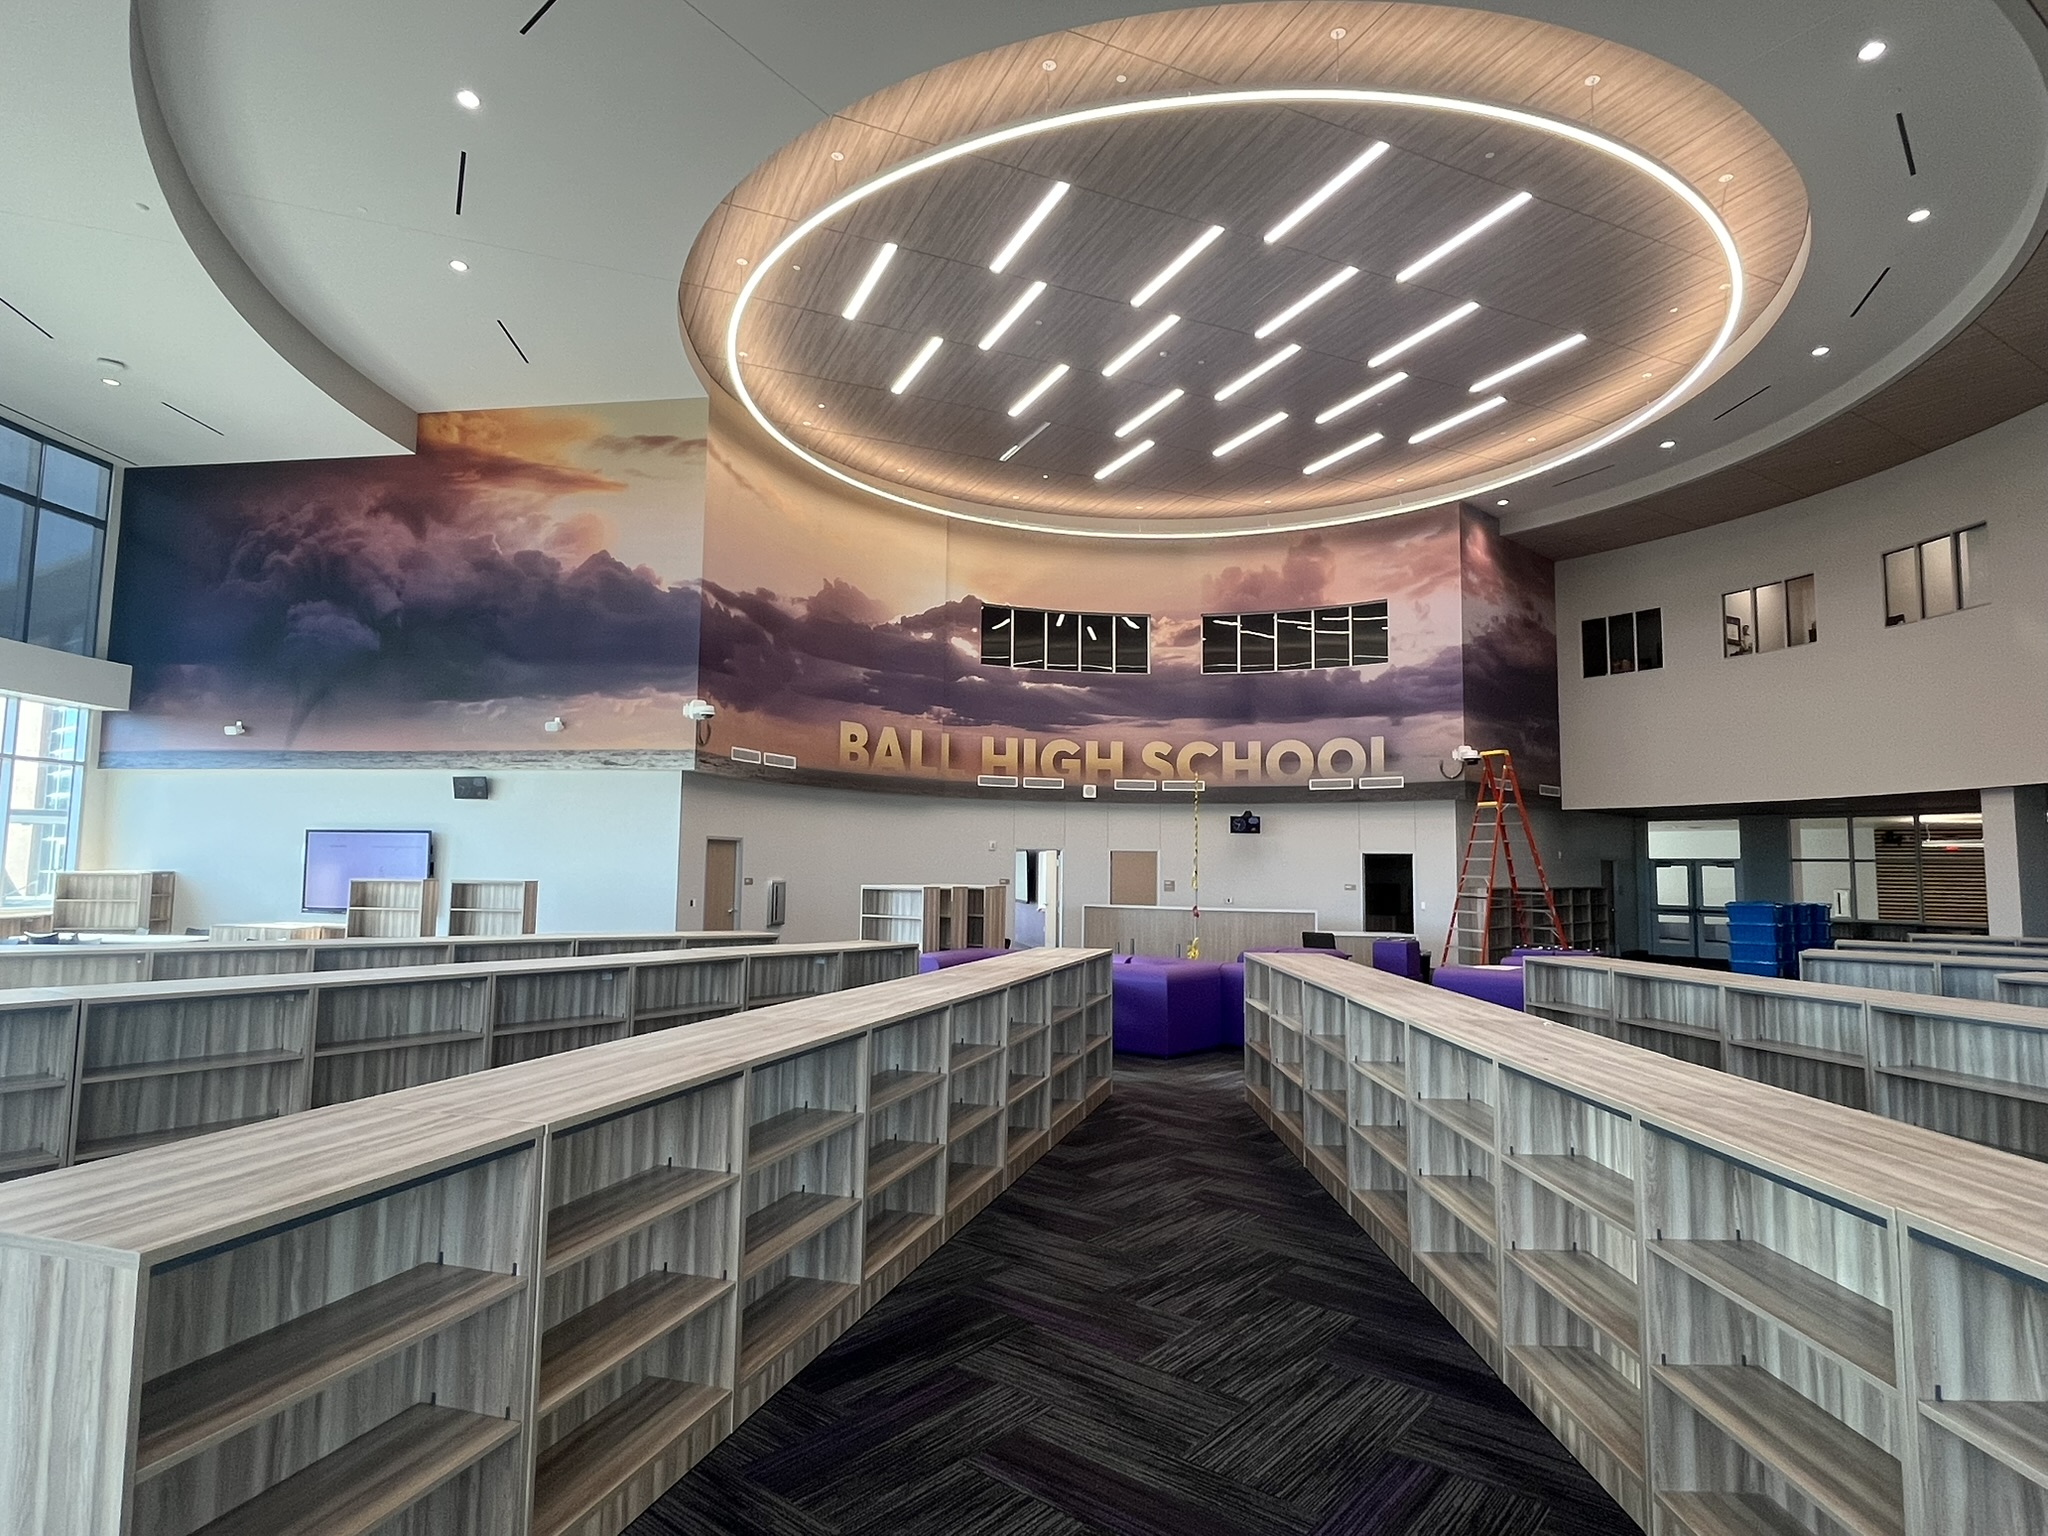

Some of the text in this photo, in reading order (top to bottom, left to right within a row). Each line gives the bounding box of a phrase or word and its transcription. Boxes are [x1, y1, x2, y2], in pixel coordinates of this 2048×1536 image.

[839, 720, 1403, 784] BALL HIGH SCHOOL
